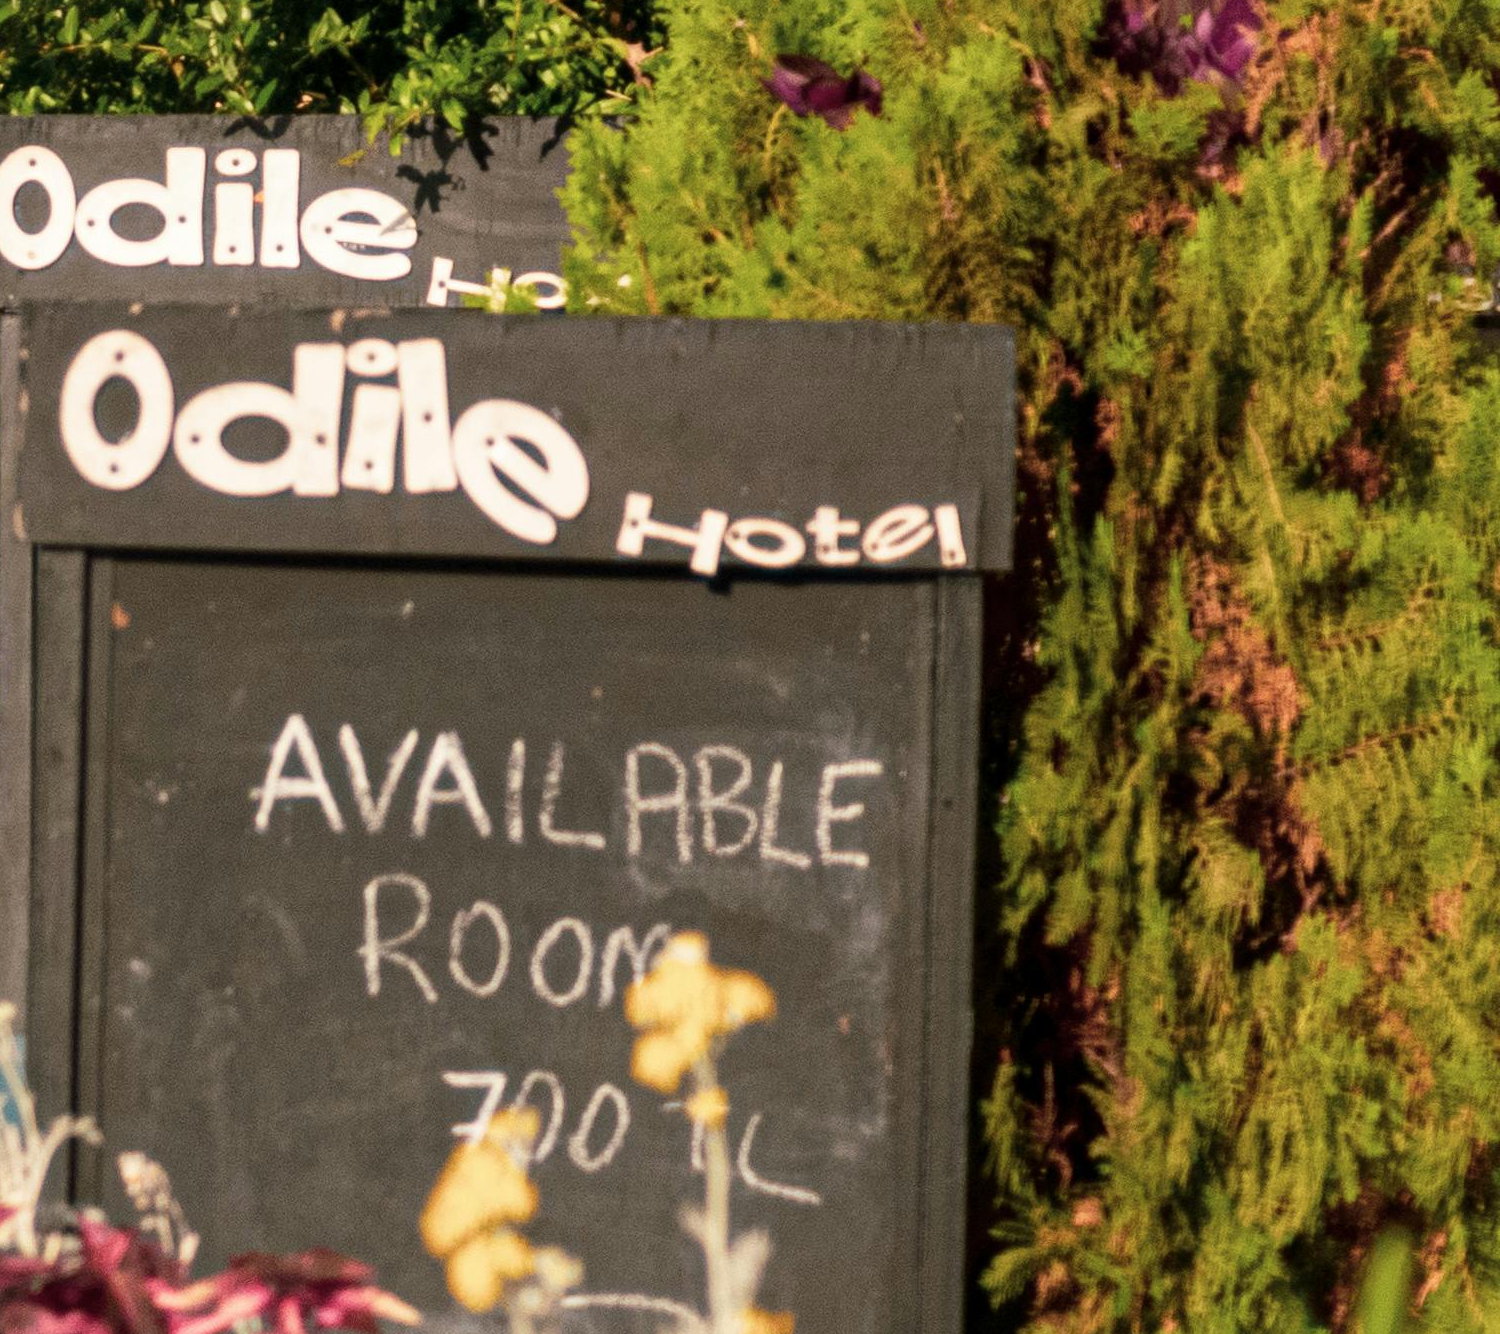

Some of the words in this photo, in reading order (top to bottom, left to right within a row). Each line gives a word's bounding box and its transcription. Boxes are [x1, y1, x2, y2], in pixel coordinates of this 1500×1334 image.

[58, 328, 589, 545] Odile
[615, 490, 969, 577] Hotel
[250, 713, 885, 868] AVAILABLE
[441, 1069, 633, 1173] 700
